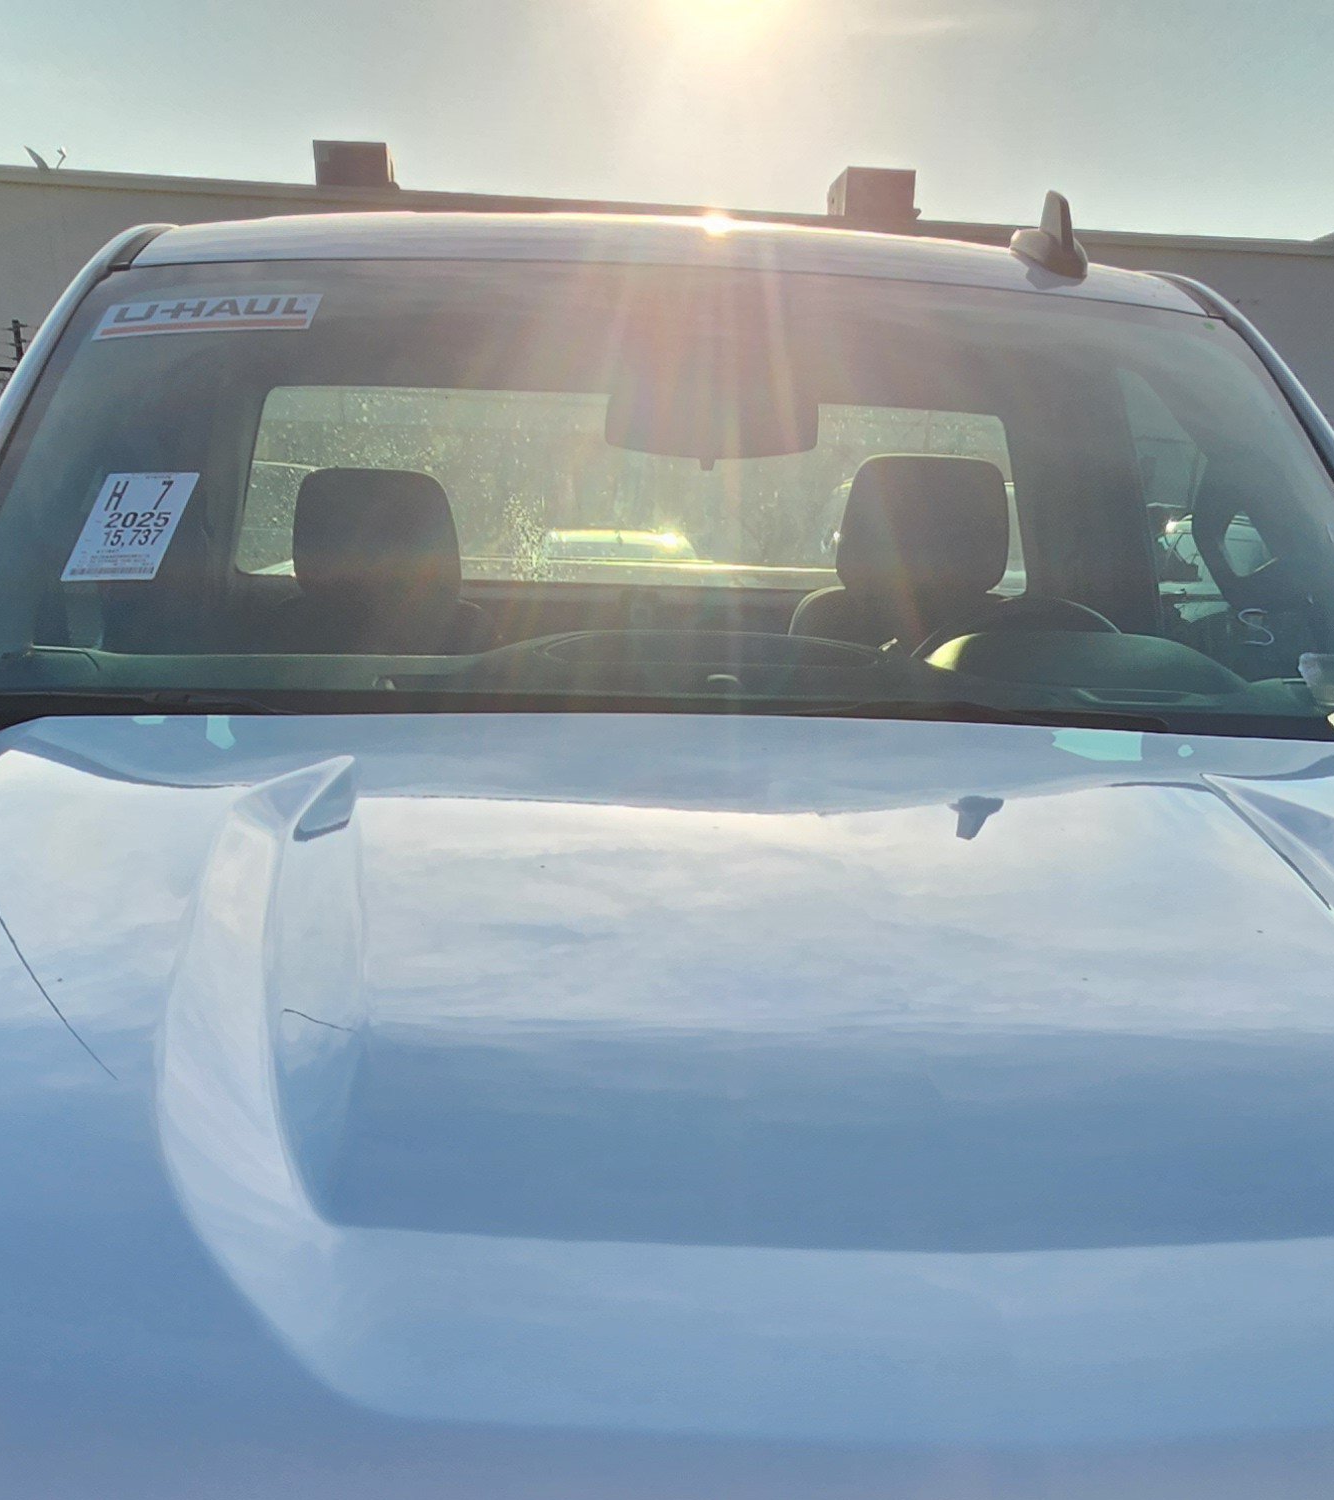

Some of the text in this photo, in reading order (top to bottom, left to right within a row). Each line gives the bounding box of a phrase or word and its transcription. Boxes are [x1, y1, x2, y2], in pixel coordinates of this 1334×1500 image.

[113, 296, 309, 324] U-HAUL
[104, 480, 174, 512] H 7
[104, 511, 171, 529] 2025
[103, 529, 165, 547] 15,737
